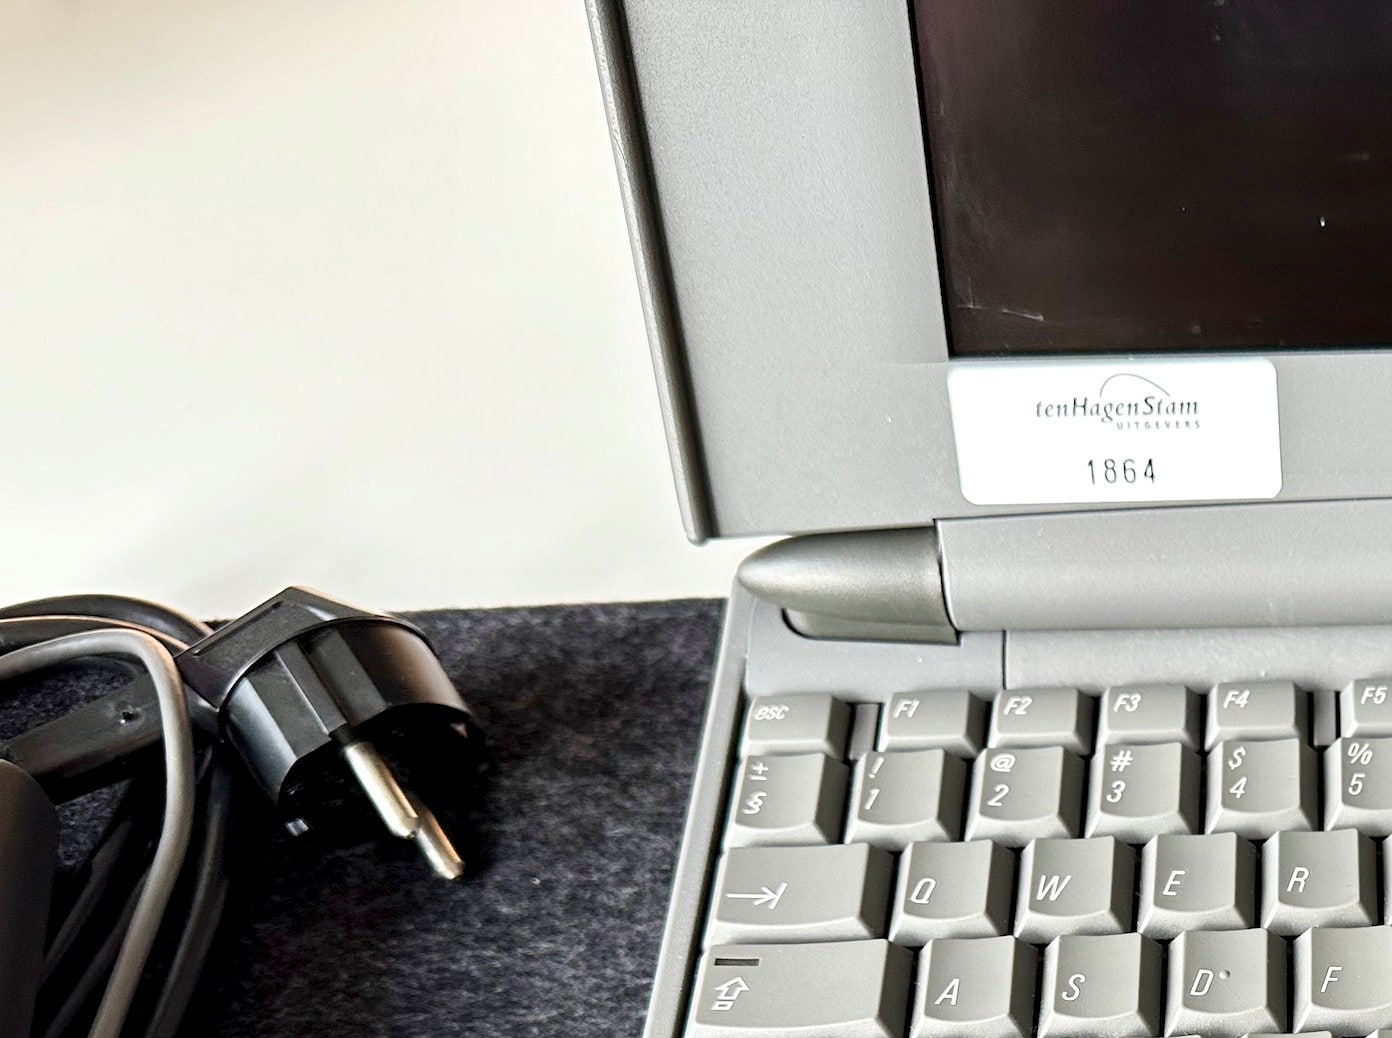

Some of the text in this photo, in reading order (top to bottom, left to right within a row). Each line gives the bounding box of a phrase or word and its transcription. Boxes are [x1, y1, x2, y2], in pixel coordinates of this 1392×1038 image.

[1036, 396, 1198, 423] tenHagenStam
[1117, 421, 1200, 429] UITGEVERS
[1088, 459, 1156, 485] 1864
[1004, 696, 1032, 714] F2
[1114, 693, 1141, 711] F3
[1224, 690, 1249, 708] F4
[1361, 687, 1387, 704] F5
[754, 704, 789, 721] esc
[893, 699, 919, 718] F1
[988, 784, 1009, 806] 2
[1107, 781, 1125, 802] 3
[1230, 777, 1247, 798] 4
[1349, 774, 1365, 795] 5
[865, 789, 880, 809] 1
[1037, 875, 1071, 901] W
[1163, 871, 1185, 895] E
[1287, 867, 1309, 892] R
[910, 878, 936, 903] Q
[1062, 974, 1085, 1000] S
[1190, 970, 1214, 995] D
[1321, 967, 1342, 992] F
[935, 979, 959, 1005] A
